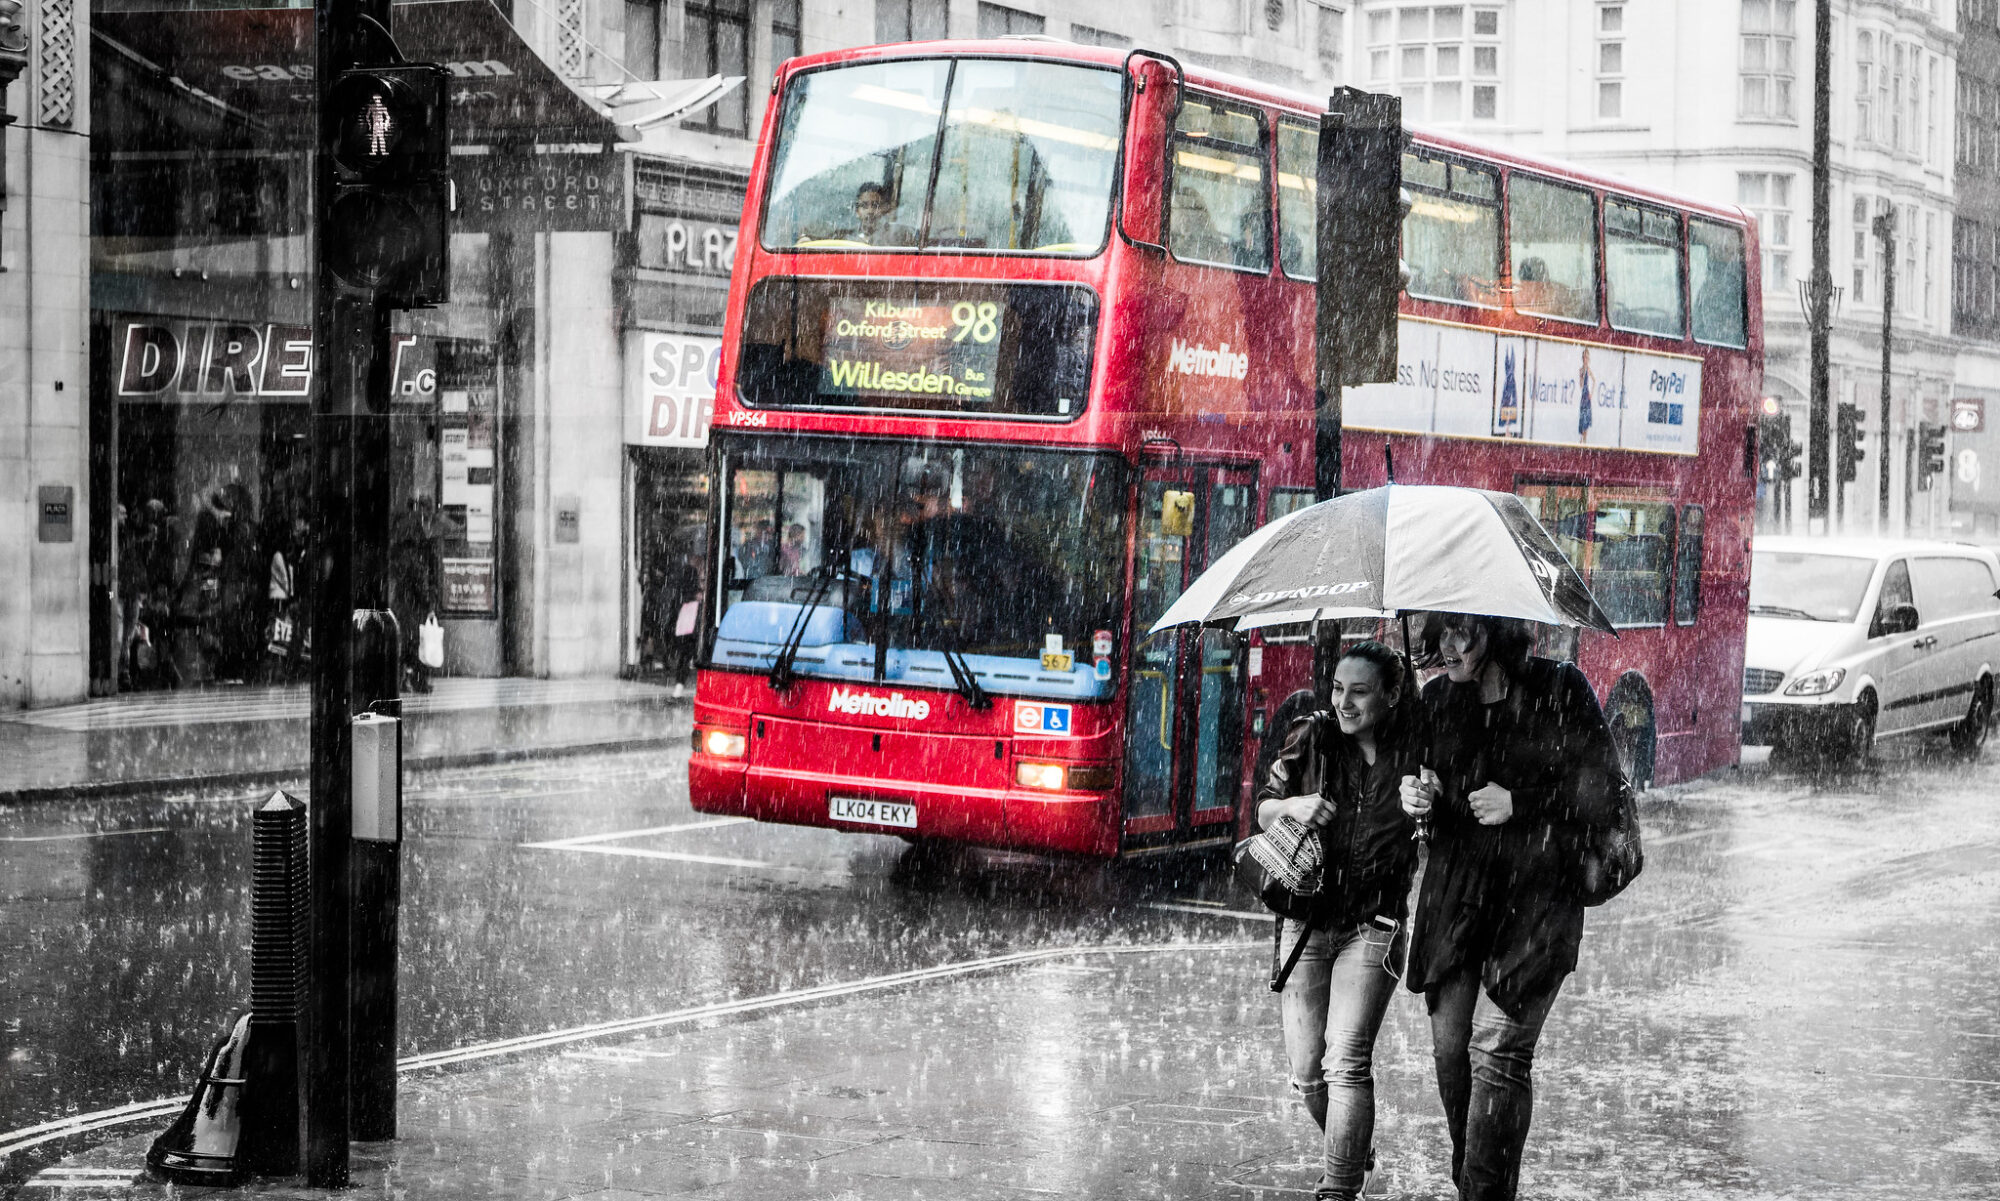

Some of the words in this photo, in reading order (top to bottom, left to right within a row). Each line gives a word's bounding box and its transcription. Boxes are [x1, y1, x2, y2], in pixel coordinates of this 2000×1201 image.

[479, 175, 600, 193] OXFORD
[480, 194, 600, 212] STREET
[865, 301, 923, 319] Kilburn
[836, 319, 895, 338] Oxford
[898, 322, 947, 340] Street
[951, 301, 998, 344] 98
[1168, 337, 1249, 380] Metroline
[830, 360, 954, 395] Willesden
[964, 368, 986, 382] Bus
[1398, 364, 1416, 387] ss.
[1419, 360, 1438, 389] No
[1442, 369, 1482, 394] stress.
[1528, 373, 1558, 403] Want
[1561, 378, 1576, 405] it?
[1597, 381, 1616, 409] Get
[1649, 369, 1686, 399] PayPal
[954, 382, 992, 398] Garage
[728, 411, 768, 427] VP564
[1250, 580, 1376, 604] DUNLOP
[1042, 654, 1071, 670] 567
[828, 687, 931, 721] Metroline
[836, 801, 876, 820] LK04
[880, 804, 912, 824] EKY
